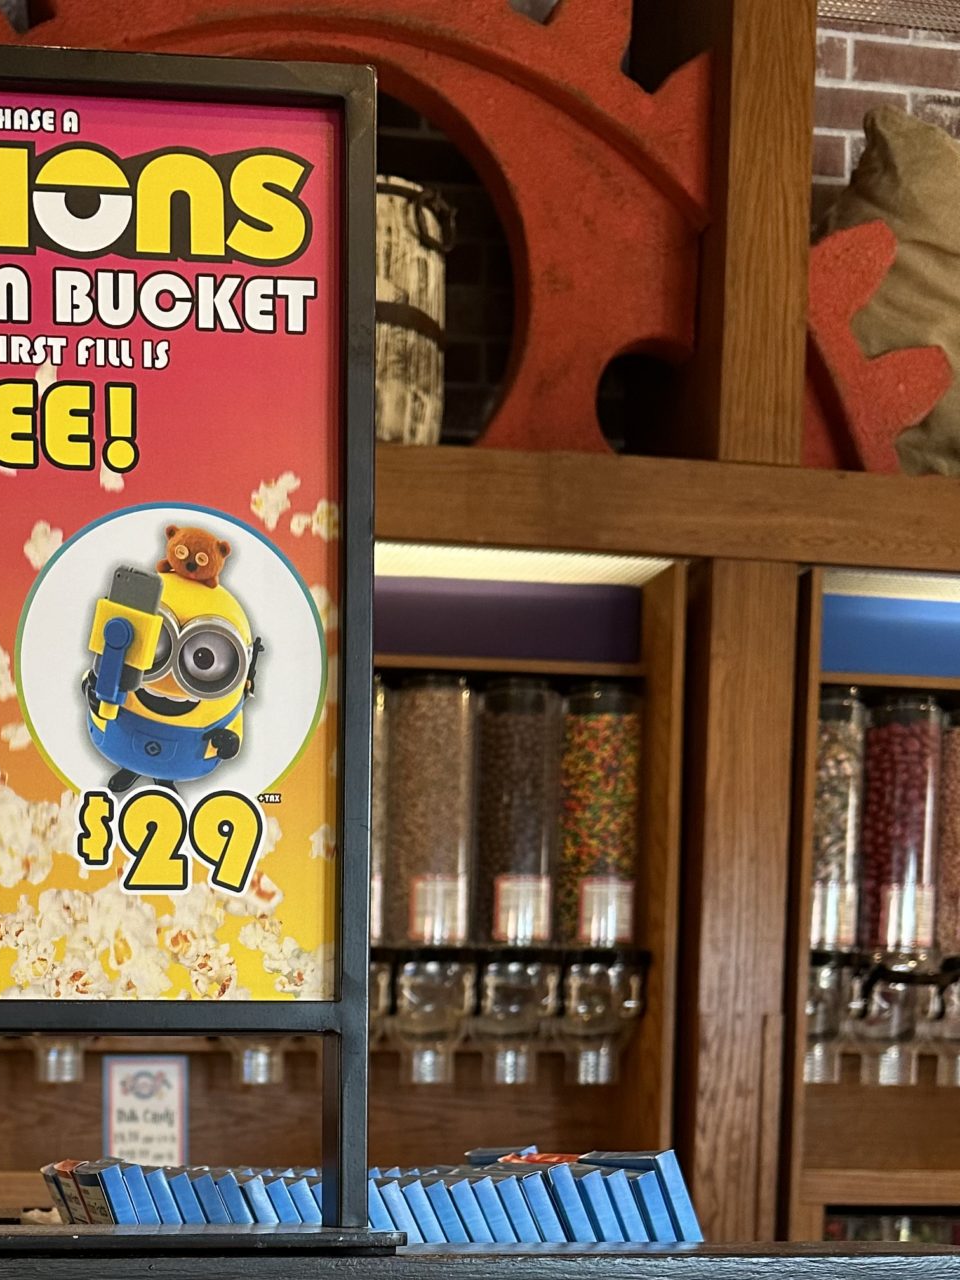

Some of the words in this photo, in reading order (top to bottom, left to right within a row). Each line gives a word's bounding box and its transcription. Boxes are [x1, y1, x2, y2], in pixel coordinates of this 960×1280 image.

[62, 110, 79, 133] A
[54, 270, 315, 333] BUCKET
[76, 338, 133, 368] FILL
[142, 340, 170, 370] IS
[77, 786, 265, 892] $29
